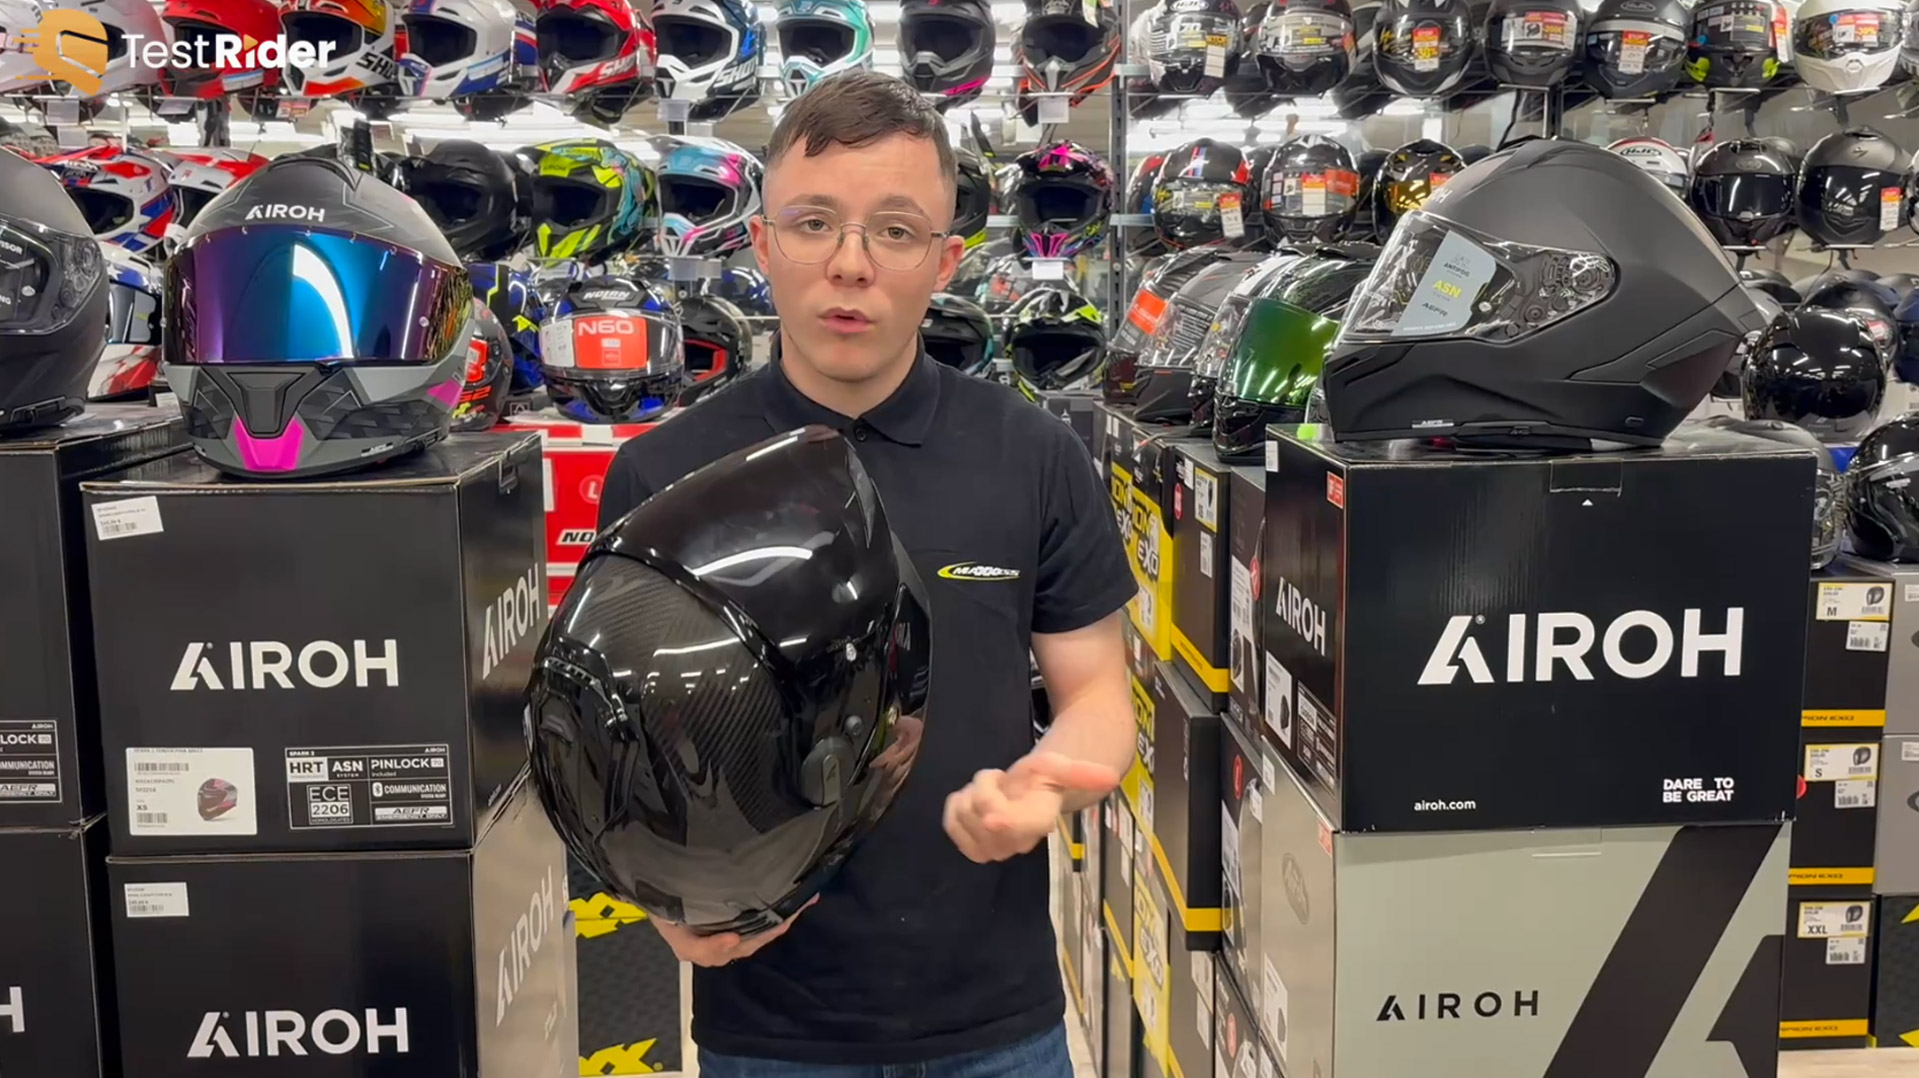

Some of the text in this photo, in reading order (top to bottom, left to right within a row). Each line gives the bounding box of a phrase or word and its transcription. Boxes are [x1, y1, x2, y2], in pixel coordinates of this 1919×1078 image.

[245, 204, 325, 222] AIROH
[583, 290, 631, 300] NOLAN
[1432, 280, 1462, 299] ASN
[578, 320, 634, 336] N60
[1275, 576, 1326, 657] AIROH
[1826, 607, 1837, 617] M
[483, 562, 540, 681] AIROH
[1417, 607, 1744, 684] AIROH
[170, 639, 399, 690] AIROH
[290, 761, 323, 773] HRT
[332, 760, 363, 772] ASN
[371, 758, 430, 769] PINLOCK
[384, 784, 447, 794] COMMUNICATION
[1663, 777, 1735, 791] DARE TO
[309, 786, 349, 802] ECE
[1662, 789, 1734, 803] BE GREAT
[312, 804, 349, 815] 2206
[1414, 799, 1476, 811] airoh.com
[1807, 925, 1828, 935] XXL
[496, 865, 554, 1029] AIROH
[1376, 990, 1538, 1022] AIROH
[187, 1007, 409, 1057] AIROH
